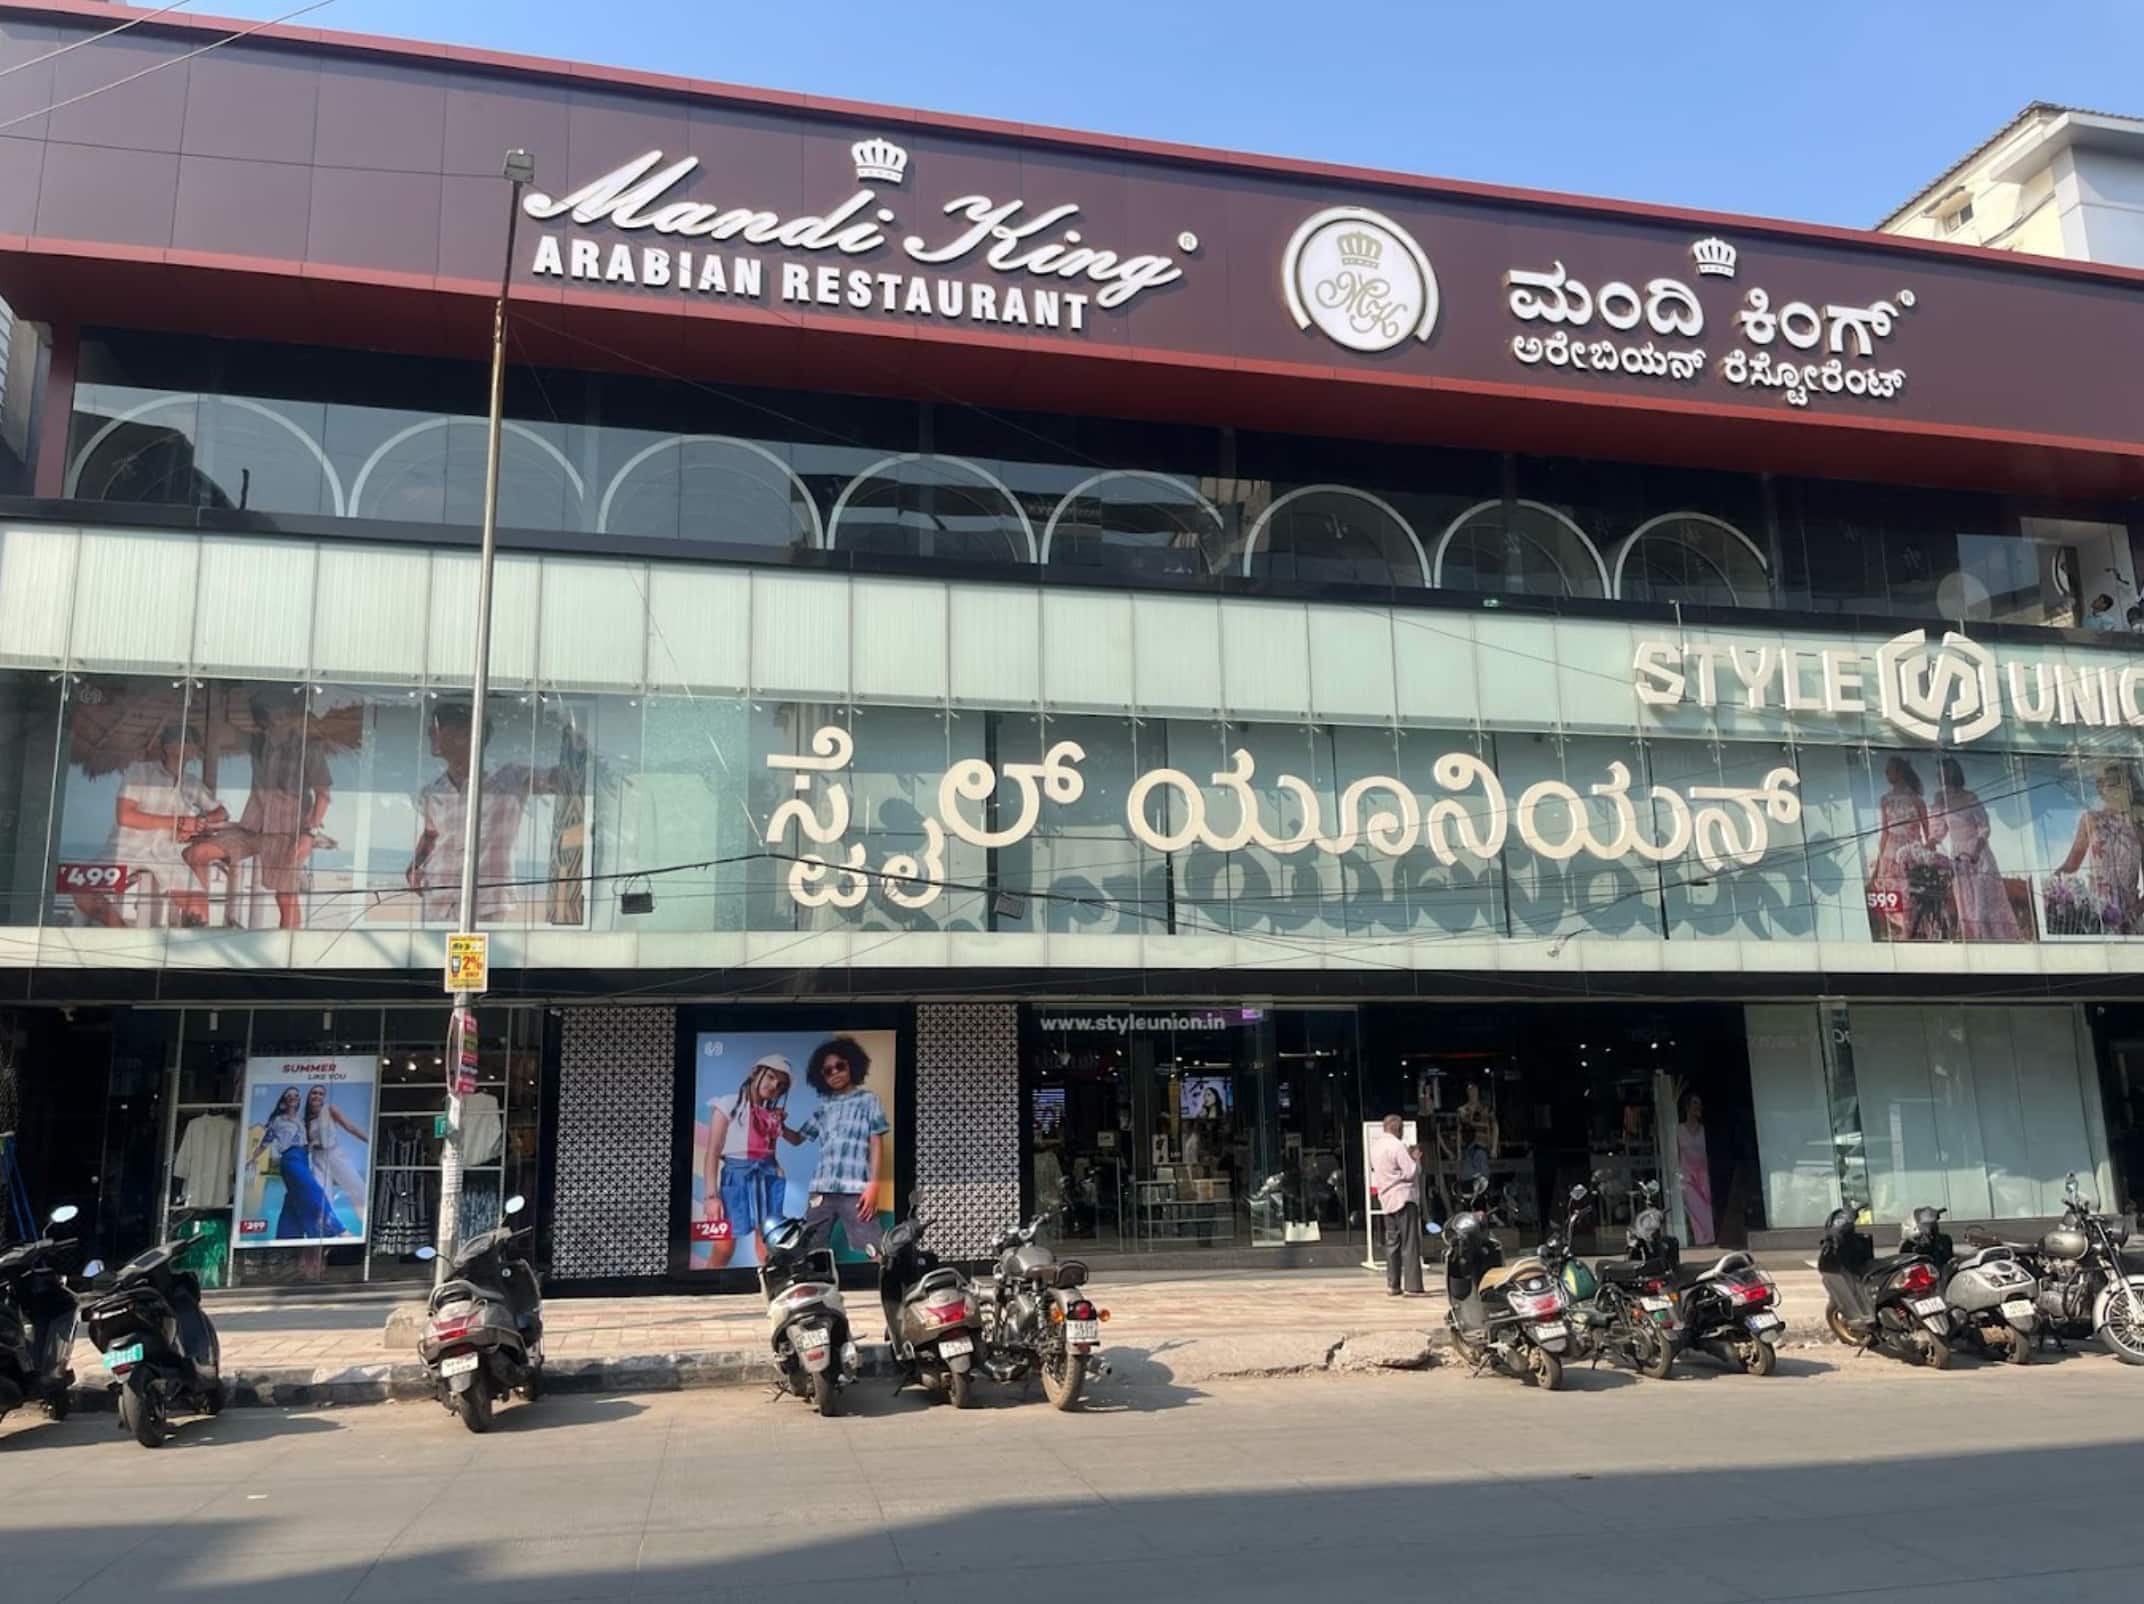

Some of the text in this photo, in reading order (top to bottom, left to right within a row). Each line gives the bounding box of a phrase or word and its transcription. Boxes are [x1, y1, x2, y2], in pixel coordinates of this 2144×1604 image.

[524, 149, 1183, 308] Mandi King
[532, 235, 1088, 330] ARABIAN RESTAURANT
[1504, 260, 1899, 356] ಮಂದಿ ಕಿಂಗ್
[1512, 330, 1707, 380] ಅರೇಬಿಯನ್
[1634, 641, 1866, 713] STYLE
[766, 725, 1801, 909] ಸ್ಟೈಲ್ ಯೂನಿಯನ್
[1040, 1012, 1226, 1036] www.styleunion.in
[282, 1063, 337, 1073] SUMMER
